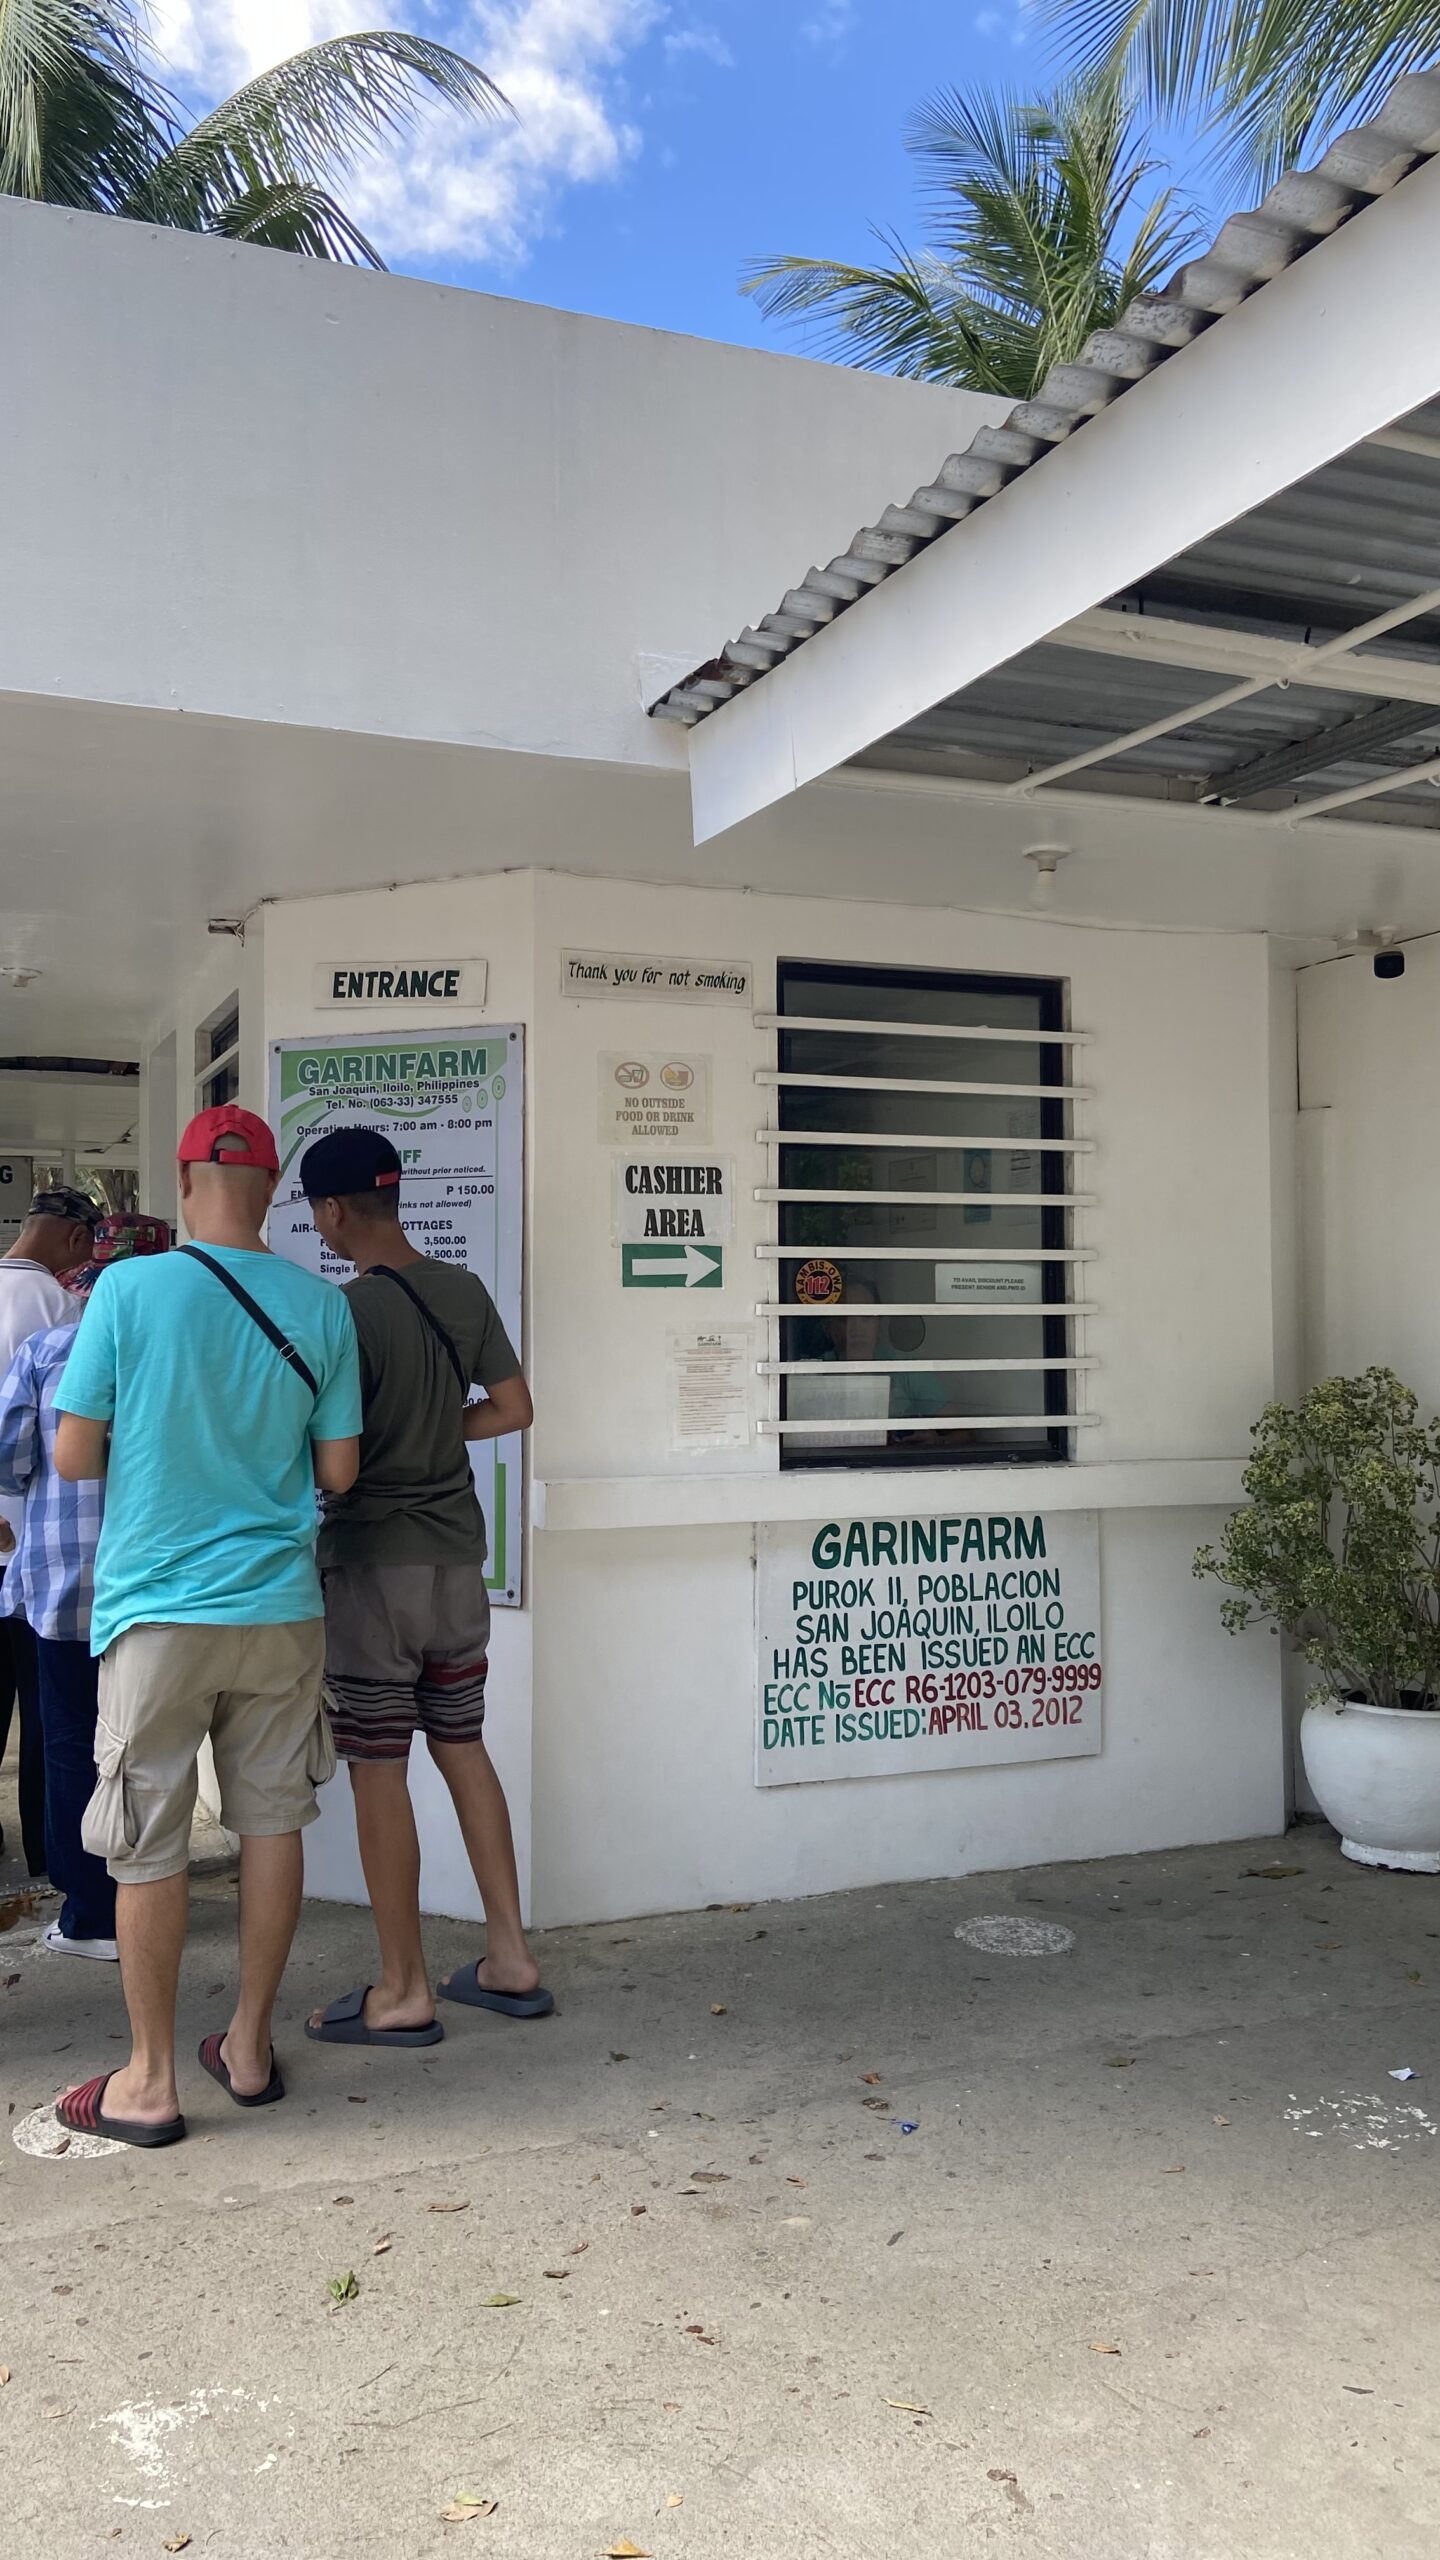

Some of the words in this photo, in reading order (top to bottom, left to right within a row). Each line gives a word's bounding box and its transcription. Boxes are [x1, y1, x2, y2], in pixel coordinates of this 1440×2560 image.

[332, 969, 461, 999] ENTRANCE
[568, 961, 607, 980] Thank
[612, 968, 638, 986] you
[641, 967, 664, 984] for
[668, 970, 691, 986] not
[695, 971, 746, 994] smoking
[297, 1048, 487, 1086] GARINFARM
[309, 1086, 329, 1096] San
[332, 1085, 380, 1098] Joaquin,
[383, 1082, 414, 1093] Iloilo,
[417, 1079, 480, 1092] Philippines
[326, 1100, 345, 1109] Tel.
[348, 1099, 366, 1109] No.
[370, 1097, 414, 1109] (063-33)
[417, 1094, 458, 1106] 347555
[624, 1097, 639, 1108] NO
[642, 1098, 685, 1109] OUTSIDE
[393, 1121, 417, 1131] 7:00
[420, 1122, 437, 1130] am
[447, 1119, 471, 1129] 8:00
[475, 1120, 492, 1131] pm
[615, 1111, 643, 1122] FOOD
[646, 1112, 660, 1122] OR
[662, 1112, 695, 1123] DRINK
[631, 1125, 679, 1136] ALLOWED
[401, 1167, 430, 1176] without
[432, 1166, 451, 1175] prior
[454, 1165, 486, 1174] noticed.
[625, 1165, 723, 1194] CASHIER
[446, 1185, 454, 1195] P
[457, 1184, 494, 1195] 150.00
[435, 1199, 472, 1208] allowed)
[402, 1220, 453, 1231] OTTAGES
[643, 1208, 705, 1237] AREA
[424, 1236, 466, 1246] 3,500.00
[320, 1264, 351, 1275] Single
[806, 1275, 830, 1295] 112
[812, 1515, 1047, 1570] GARINFARM
[792, 1577, 876, 1611] PUROK
[918, 1567, 1061, 1606] POBLACION
[795, 1612, 850, 1645] SAN
[860, 1605, 981, 1640] JOAQUIN,
[986, 1601, 1064, 1634] ILOILO
[773, 1647, 829, 1679] HAS
[841, 1642, 907, 1676] BEEN
[921, 1637, 1009, 1670] ISSUED
[1016, 1633, 1046, 1665] AN
[1054, 1631, 1096, 1663] ECC
[763, 1682, 811, 1716] ECC
[854, 1678, 896, 1708] ECC
[905, 1662, 1103, 1705] R6-1203-079-9999
[762, 1715, 826, 1750] DATE
[835, 1708, 928, 1743] ISSUED:
[928, 1701, 989, 1736] APRIL
